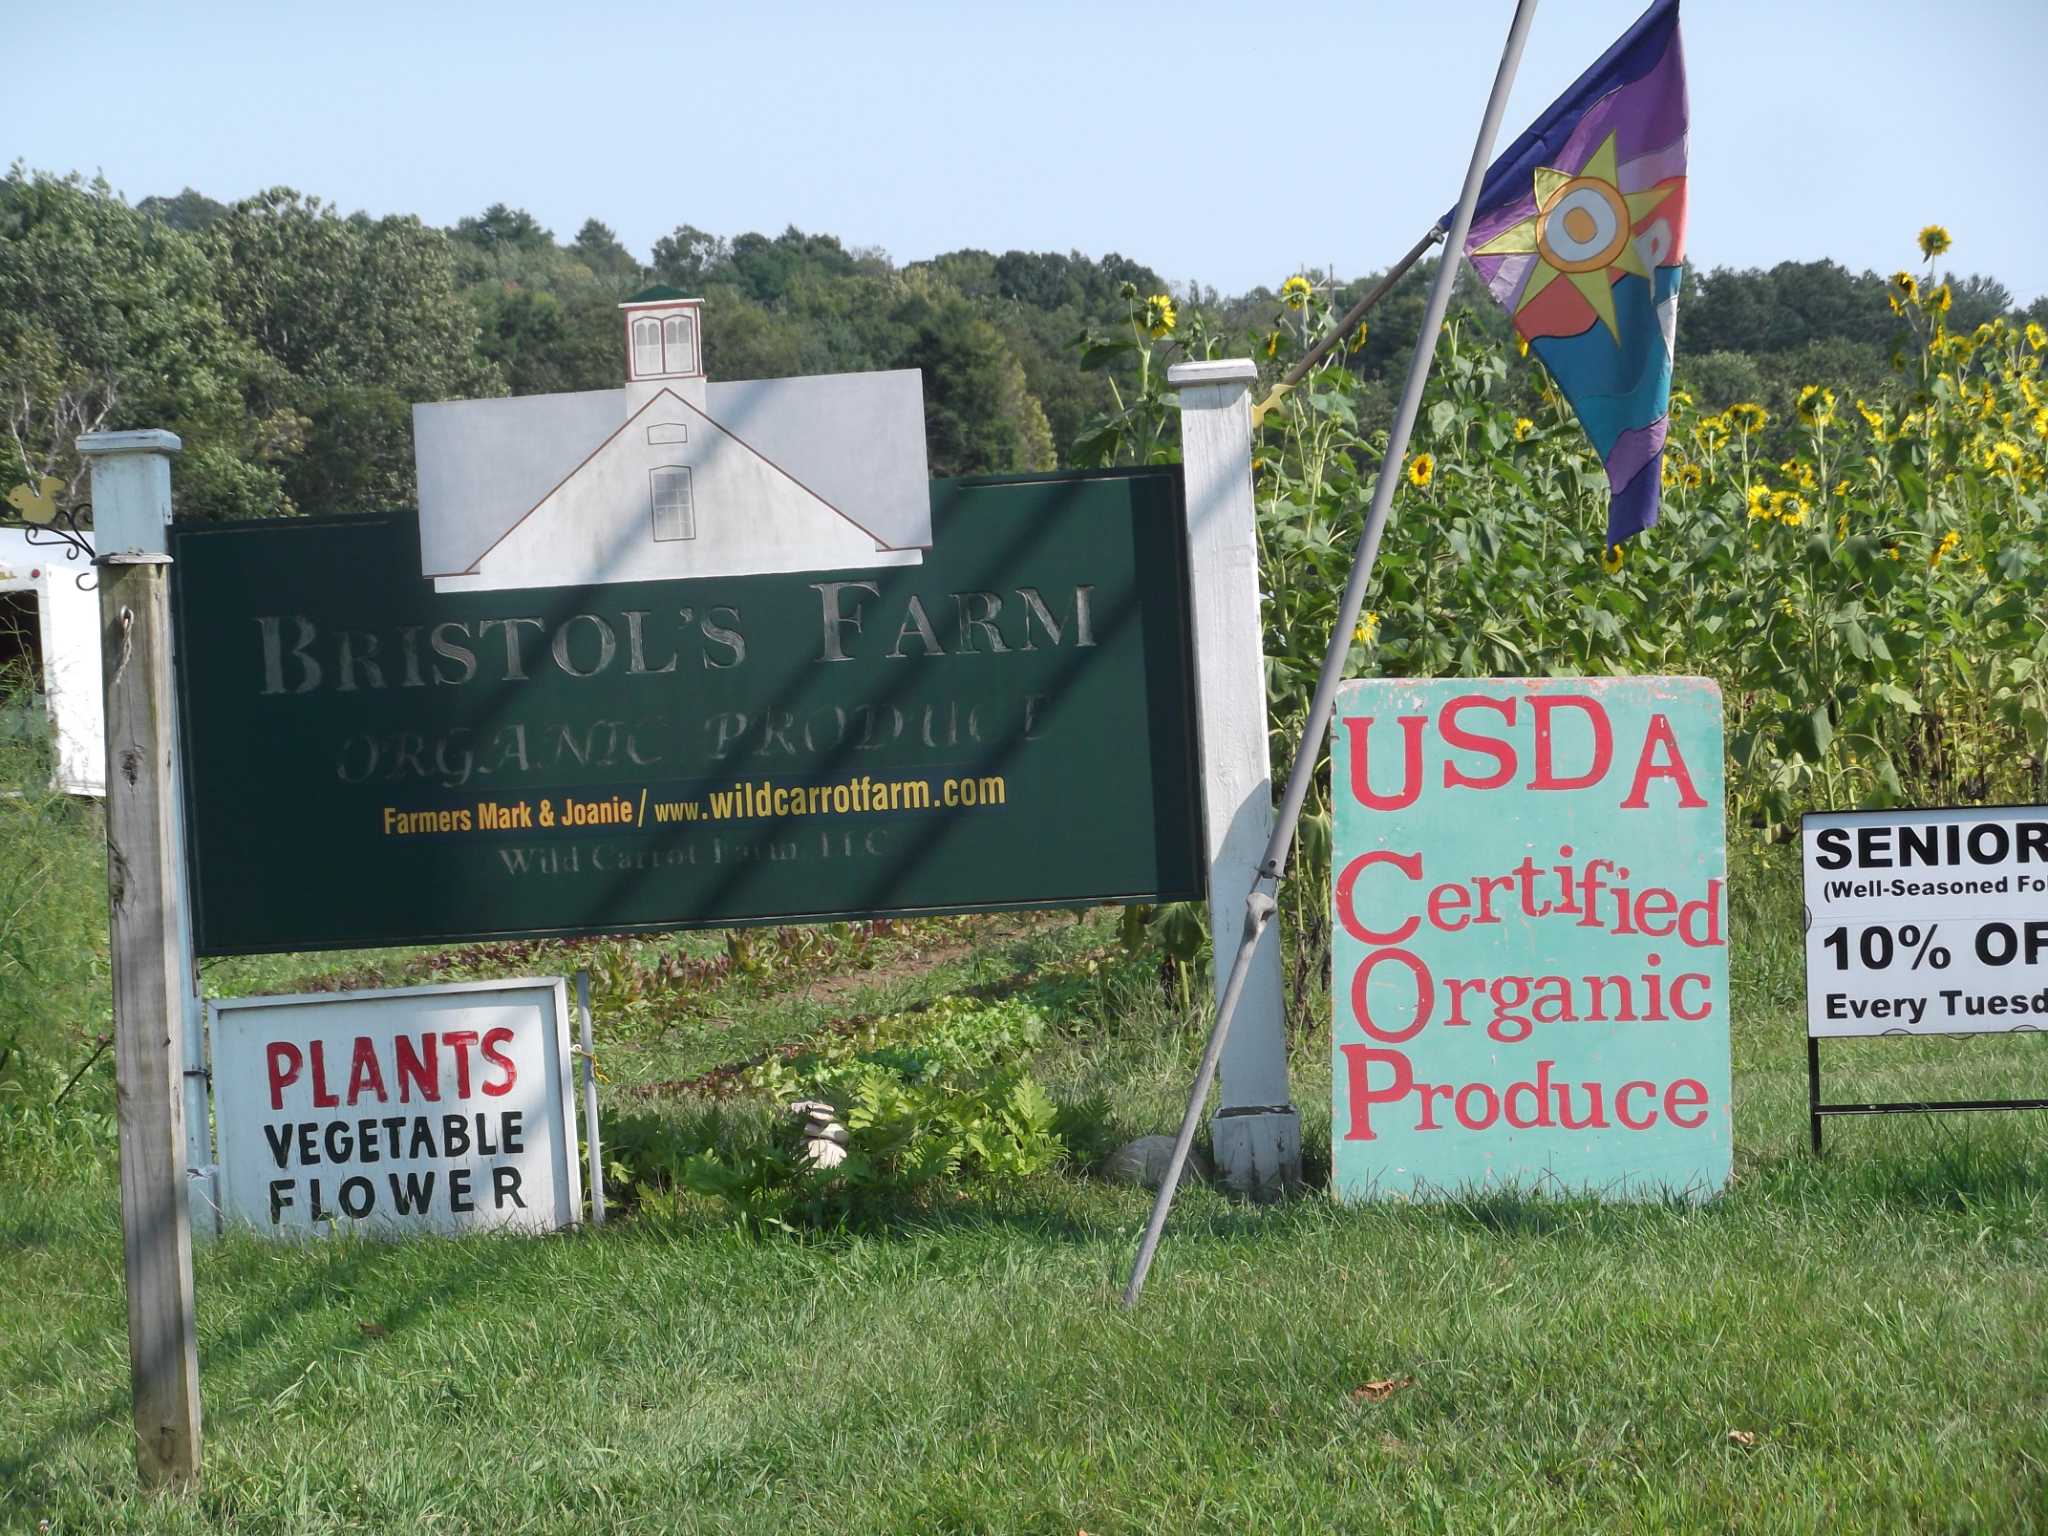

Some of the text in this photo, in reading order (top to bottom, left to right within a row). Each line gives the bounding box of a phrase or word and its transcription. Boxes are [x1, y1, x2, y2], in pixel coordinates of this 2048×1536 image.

[254, 580, 1097, 696] BRISTOL'S FARM
[336, 693, 1048, 788] ORGANIC PRODUCE
[1343, 695, 1708, 811] USDA
[384, 807, 472, 834] Farmers
[478, 801, 532, 830] Mark
[538, 799, 555, 828] &
[562, 796, 633, 826] Joanie
[655, 775, 1006, 824] www.wildcarrotfarm.com
[497, 846, 579, 875] Wild
[1815, 822, 2048, 870] SENIOR
[1336, 845, 1726, 948] Certified
[1824, 876, 2008, 903] (Well-Seasoned
[1824, 923, 1951, 971] 10%
[1351, 947, 1712, 1044] Organic
[1826, 993, 1927, 1025] Every
[266, 1027, 517, 1110] PLANTS
[1340, 1043, 1709, 1140] Produce
[264, 1111, 524, 1168] VEGETABLE
[268, 1166, 528, 1225] FLOWER
